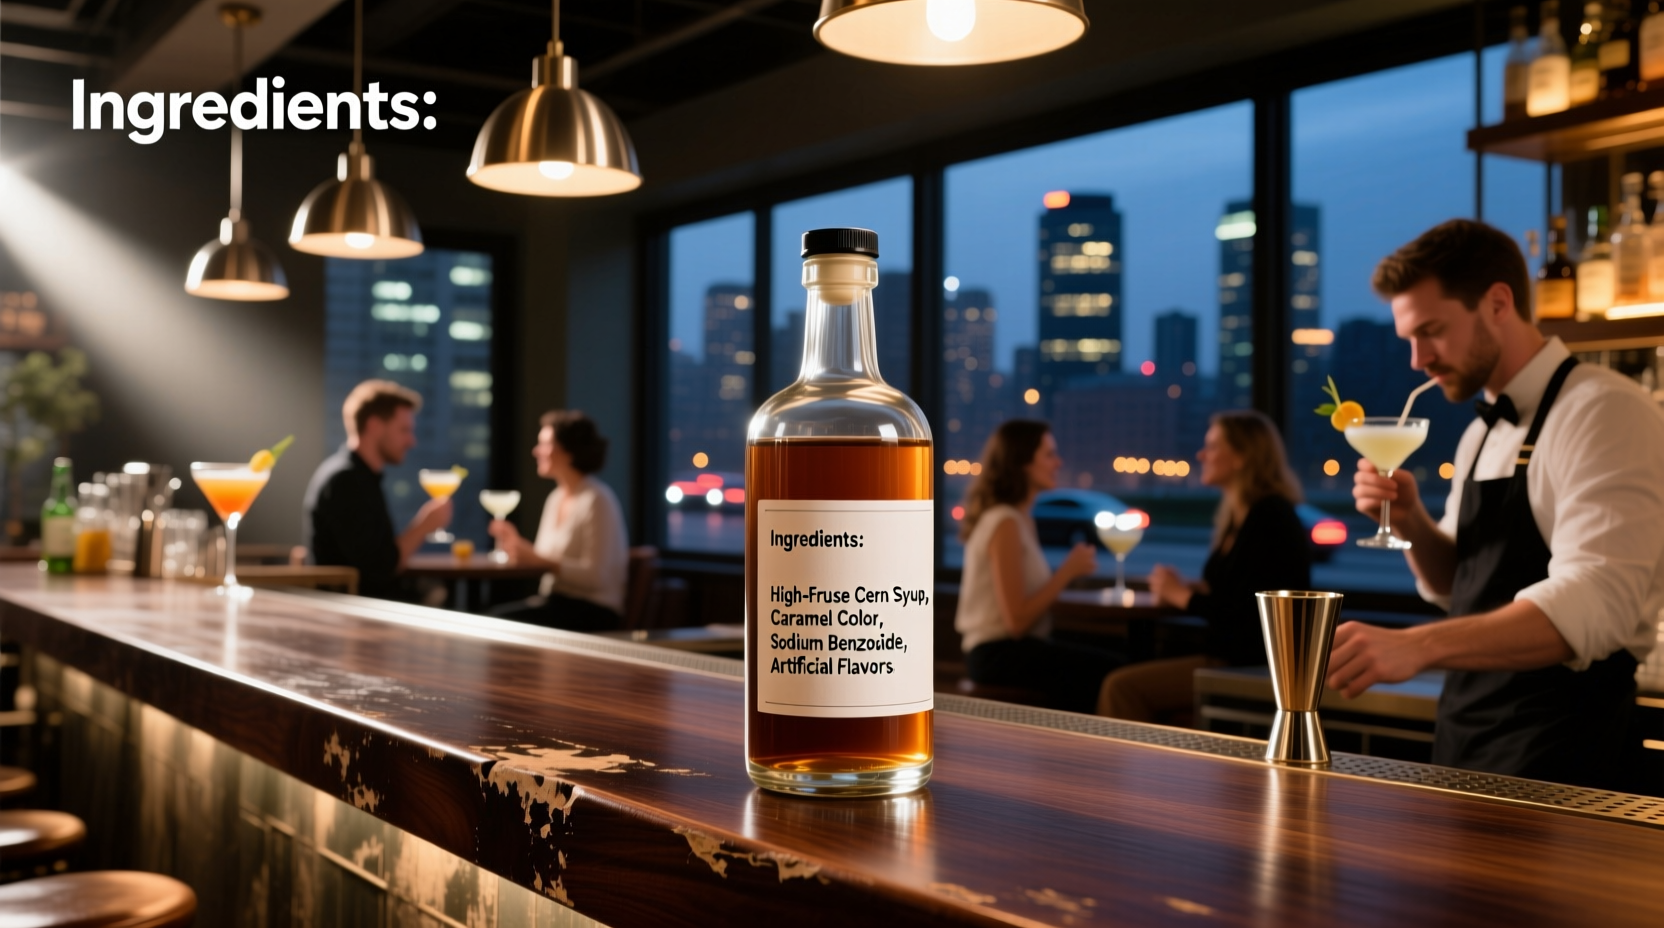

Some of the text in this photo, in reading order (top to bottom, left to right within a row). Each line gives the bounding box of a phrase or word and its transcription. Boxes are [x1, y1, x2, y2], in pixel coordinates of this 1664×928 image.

[770, 529, 864, 552] Ingredients:
[770, 585, 929, 607] High-Fruse Cern Syup,
[770, 609, 883, 629] Caramel Color,
[770, 632, 824, 651] Sodium
[770, 655, 833, 675] Artificial
